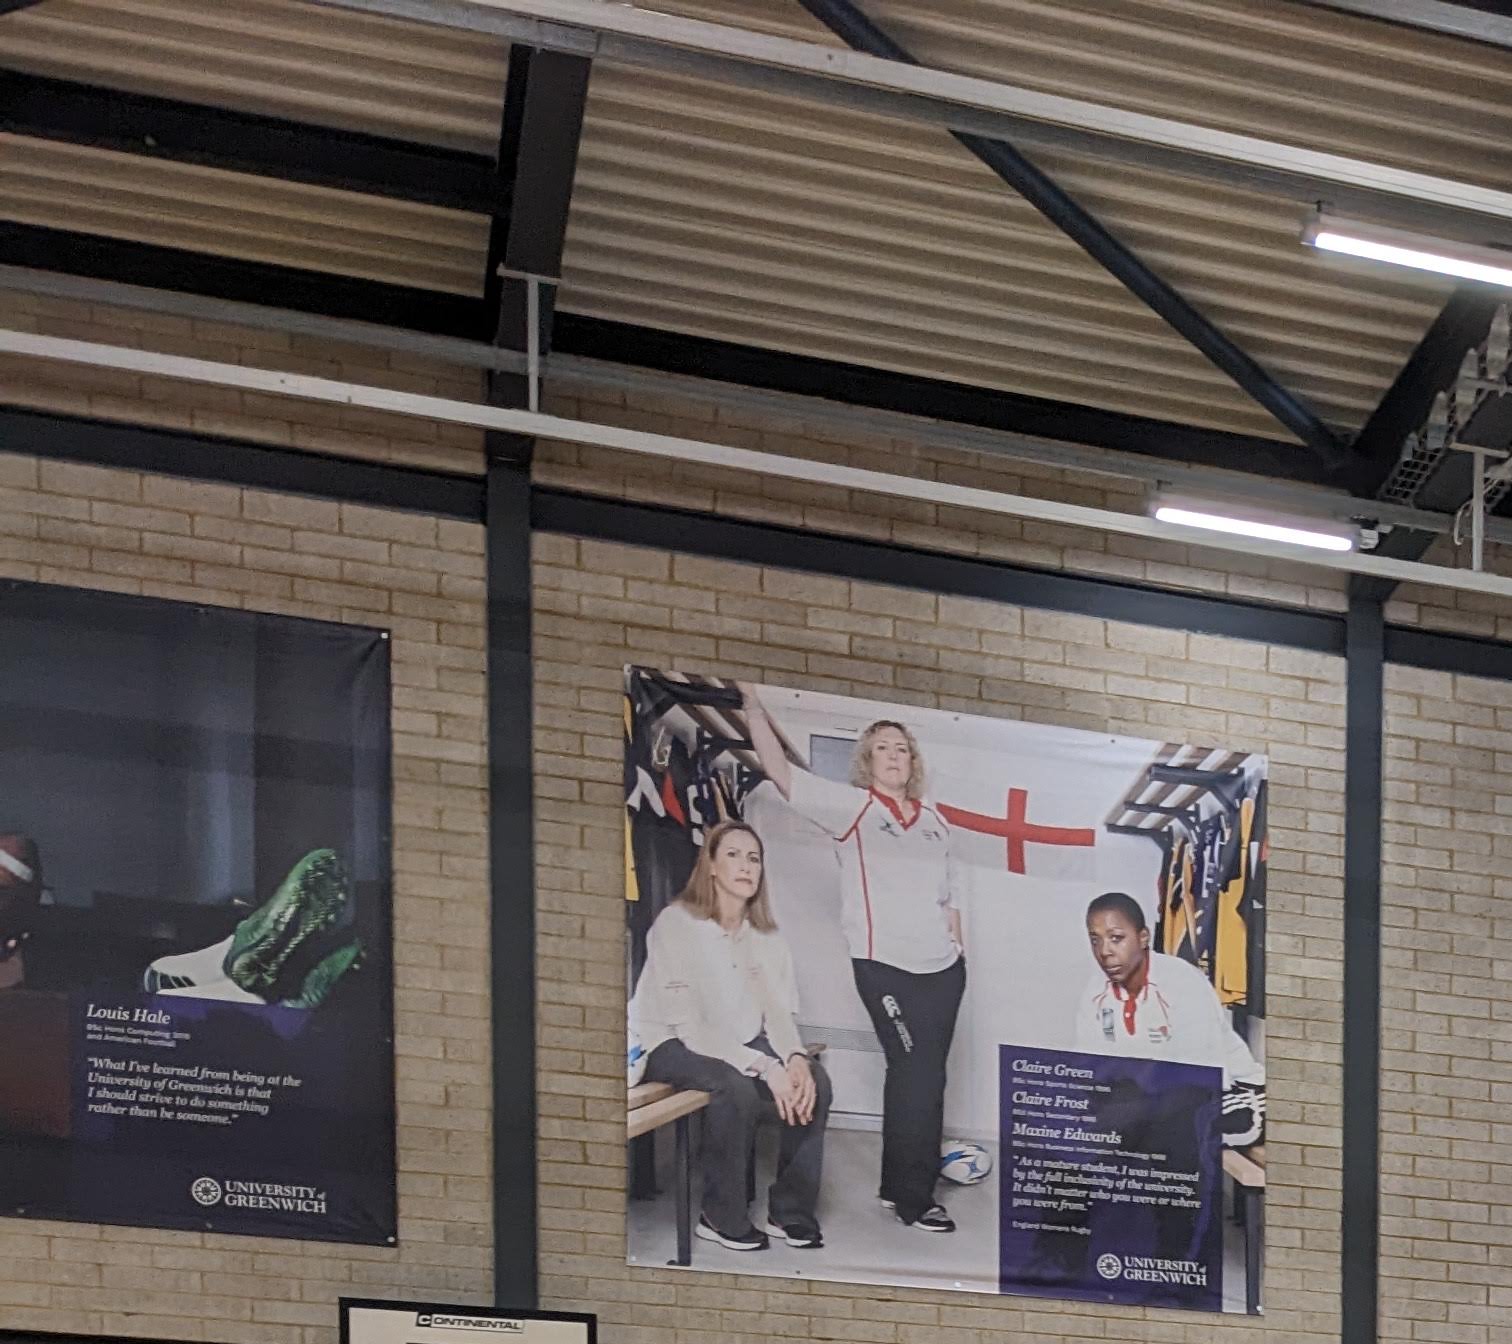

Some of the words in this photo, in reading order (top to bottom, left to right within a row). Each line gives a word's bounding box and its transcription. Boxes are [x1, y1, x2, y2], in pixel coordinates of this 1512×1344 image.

[86, 1004, 130, 1021] Louis
[133, 1008, 171, 1024] Hale
[128, 1061, 150, 1072] I've
[153, 1063, 198, 1077] learned
[198, 1068, 229, 1080] from
[233, 1071, 264, 1085] being
[267, 1075, 280, 1084] at
[283, 1076, 303, 1087] the
[1012, 1059, 1052, 1074] Claire
[1054, 1064, 1094, 1079] Green
[88, 1072, 151, 1090] University
[154, 1078, 169, 1091] of
[169, 1080, 233, 1095] Greenwich
[235, 1085, 245, 1095] is
[248, 1087, 272, 1099] that
[87, 1087, 94, 1097] I
[96, 1088, 136, 1101] should
[139, 1093, 173, 1104] strive
[175, 1095, 187, 1105] to
[190, 1095, 205, 1106] do
[208, 1099, 269, 1115] something
[1012, 1091, 1052, 1106] Claire
[1054, 1095, 1089, 1109] Frost
[87, 1103, 127, 1115] rather
[129, 1106, 157, 1118] than
[160, 1108, 174, 1119] be
[1012, 1122, 1061, 1138] Maxine
[1063, 1127, 1122, 1144] Edwards
[1043, 1160, 1079, 1170] mature
[1121, 1166, 1127, 1175] I
[1129, 1168, 1148, 1177] was
[1151, 1168, 1199, 1182] impressed
[225, 1180, 316, 1198] UNIVERSITY
[1013, 1169, 1025, 1180] by
[1027, 1170, 1043, 1180] the
[1043, 1172, 1062, 1183] full
[1116, 1178, 1126, 1190] of
[1128, 1178, 1143, 1189] the
[1144, 1182, 1195, 1196] university.
[225, 1194, 326, 1213] GREENWICH
[1013, 1182, 1021, 1192] It
[1023, 1183, 1052, 1195] didn't
[1054, 1187, 1088, 1196] matter
[1089, 1189, 1110, 1199] who
[1112, 1192, 1131, 1203] you
[1133, 1195, 1156, 1204] were
[1158, 1197, 1170, 1205] or
[1171, 1198, 1201, 1209] where
[1013, 1197, 1031, 1208] you
[1034, 1199, 1058, 1208] were
[1124, 1256, 1199, 1273] UNIVERSITY
[1123, 1269, 1207, 1286] GREENWICH
[418, 1313, 522, 1330] CONTINENTAL
